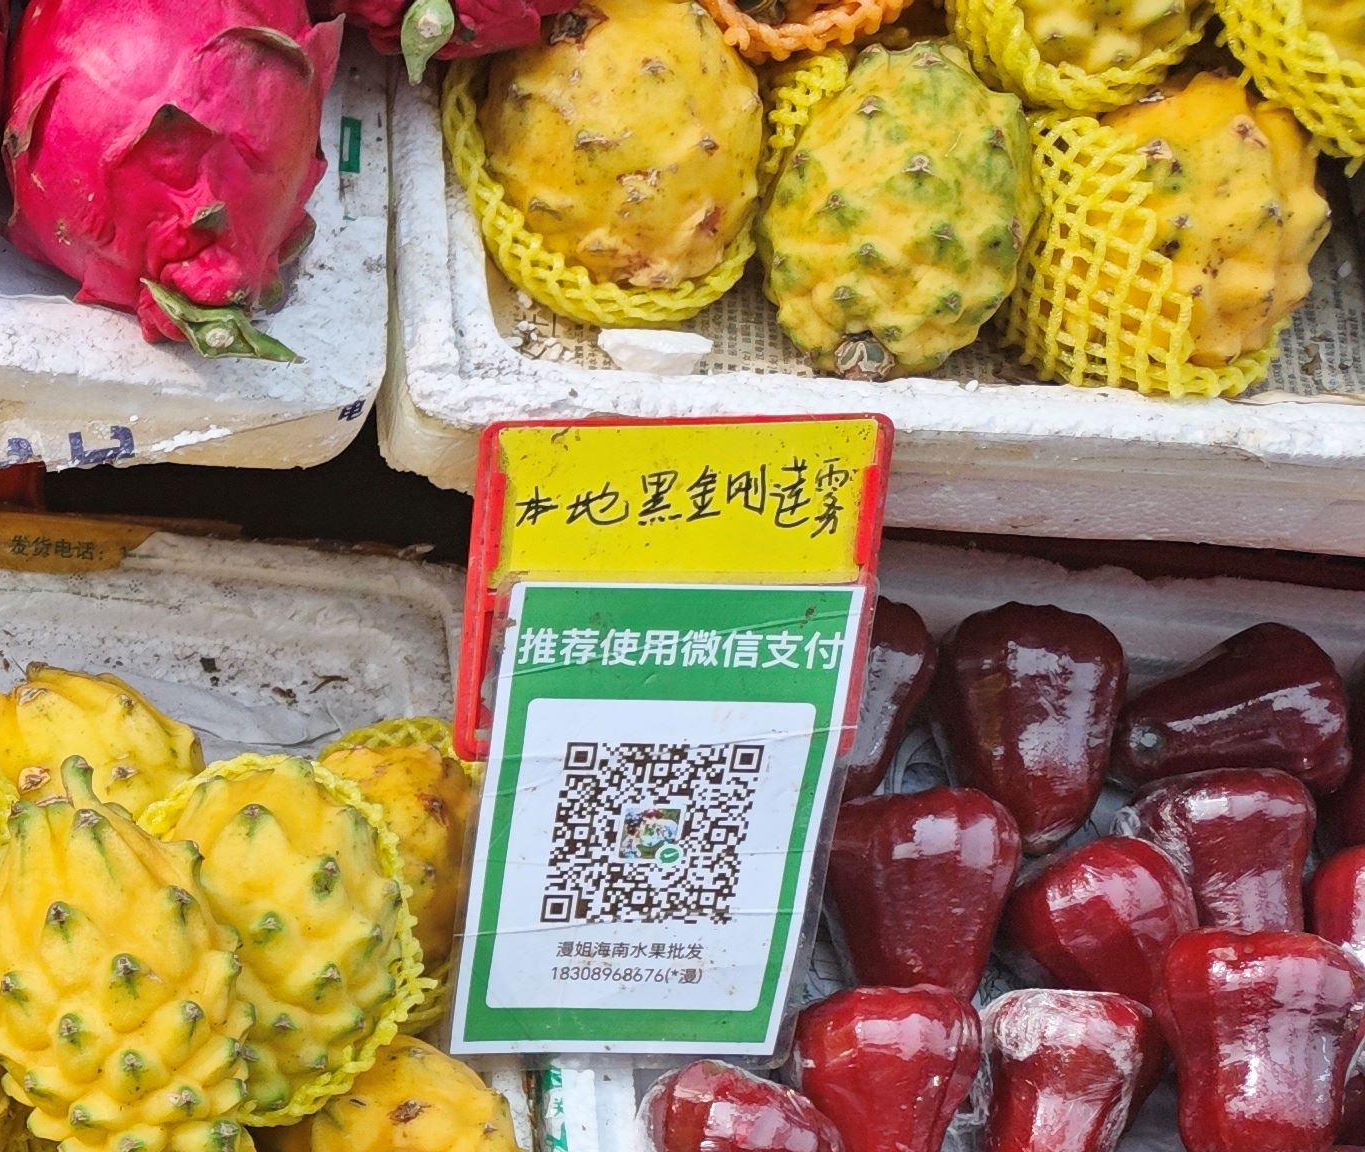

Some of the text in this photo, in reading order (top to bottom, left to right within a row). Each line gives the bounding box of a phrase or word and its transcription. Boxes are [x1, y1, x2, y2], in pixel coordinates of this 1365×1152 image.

[518, 627, 846, 670] 推荐使用微信支付
[555, 940, 705, 961] 漫姐海南水果批发
